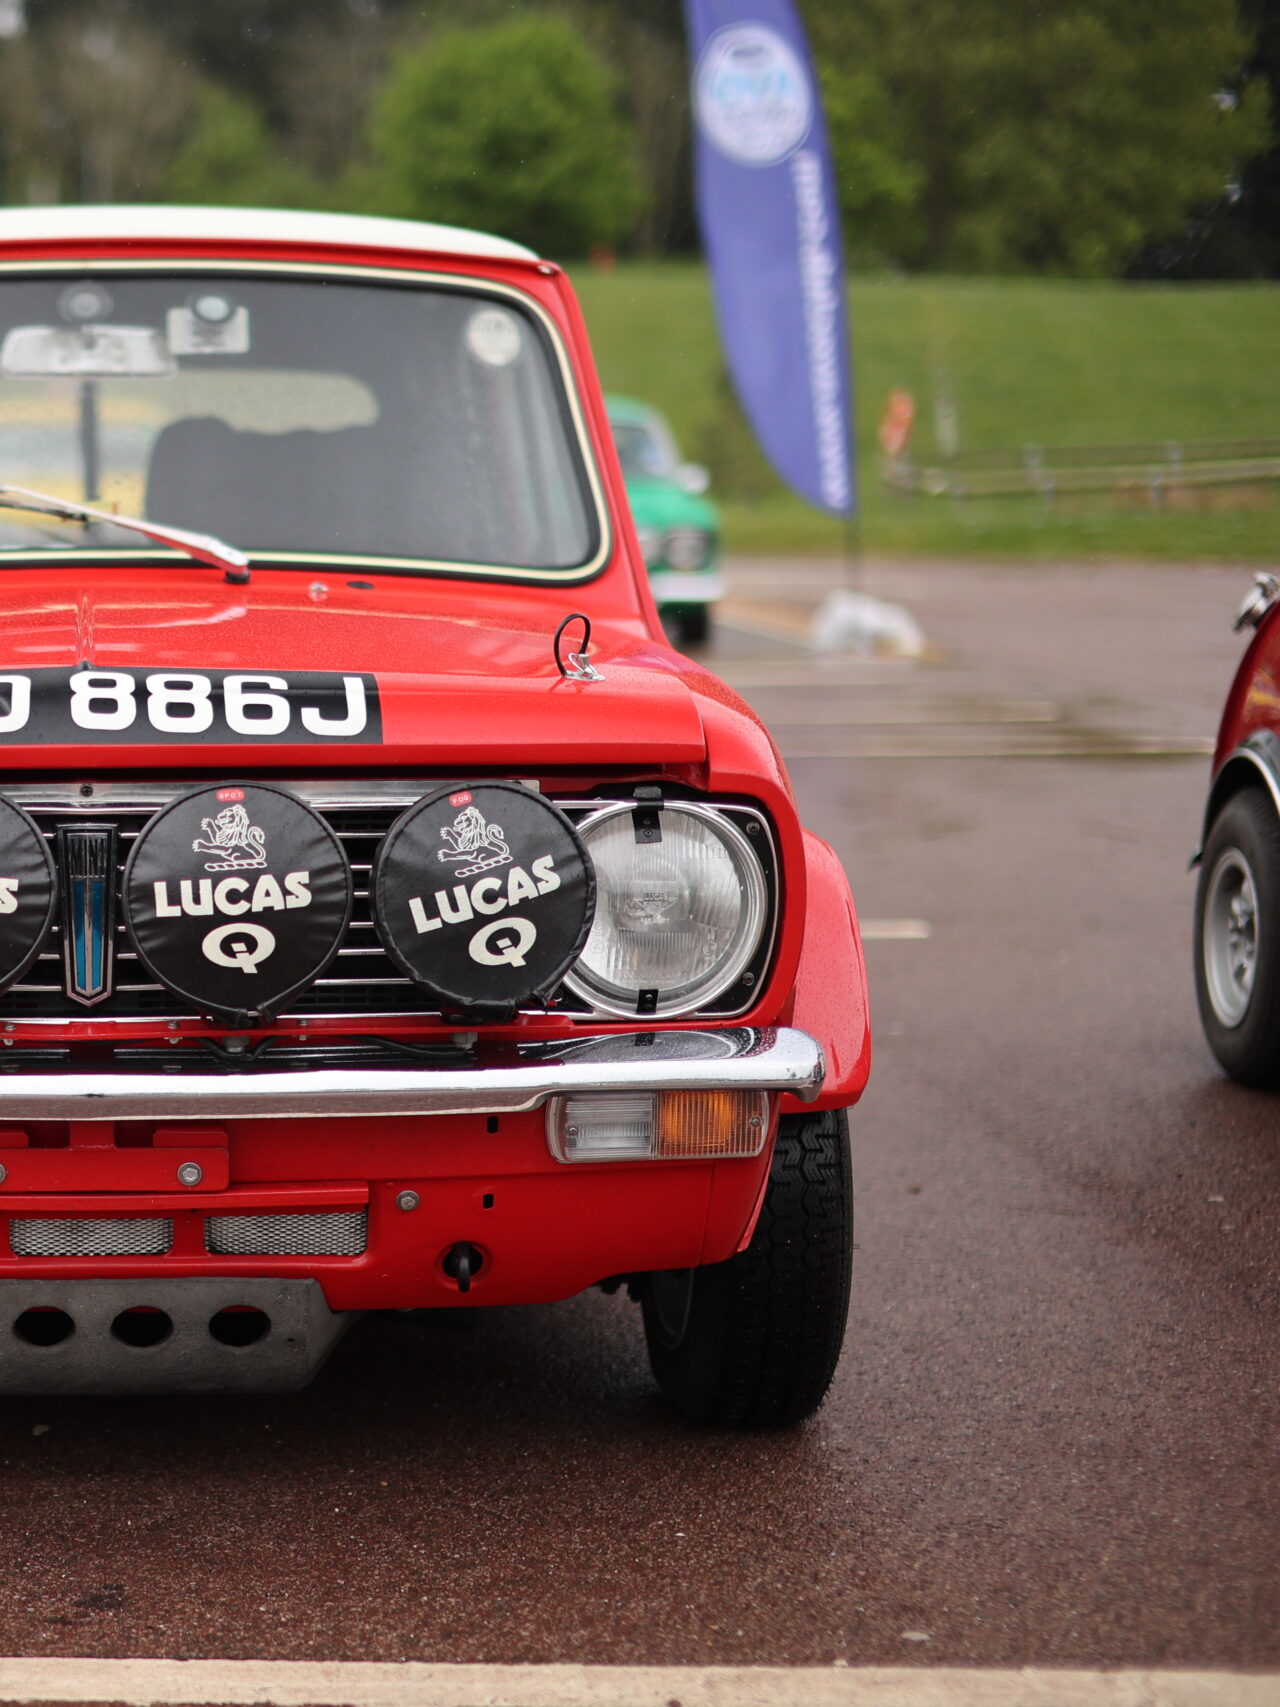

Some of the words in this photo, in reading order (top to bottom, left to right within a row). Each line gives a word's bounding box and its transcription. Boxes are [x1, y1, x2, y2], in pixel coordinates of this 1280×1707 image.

[69, 671, 369, 736] 886J
[154, 871, 311, 917] LUCAS
[408, 855, 562, 934] LUCAS
[202, 923, 275, 973] Q
[468, 917, 537, 967] Q
